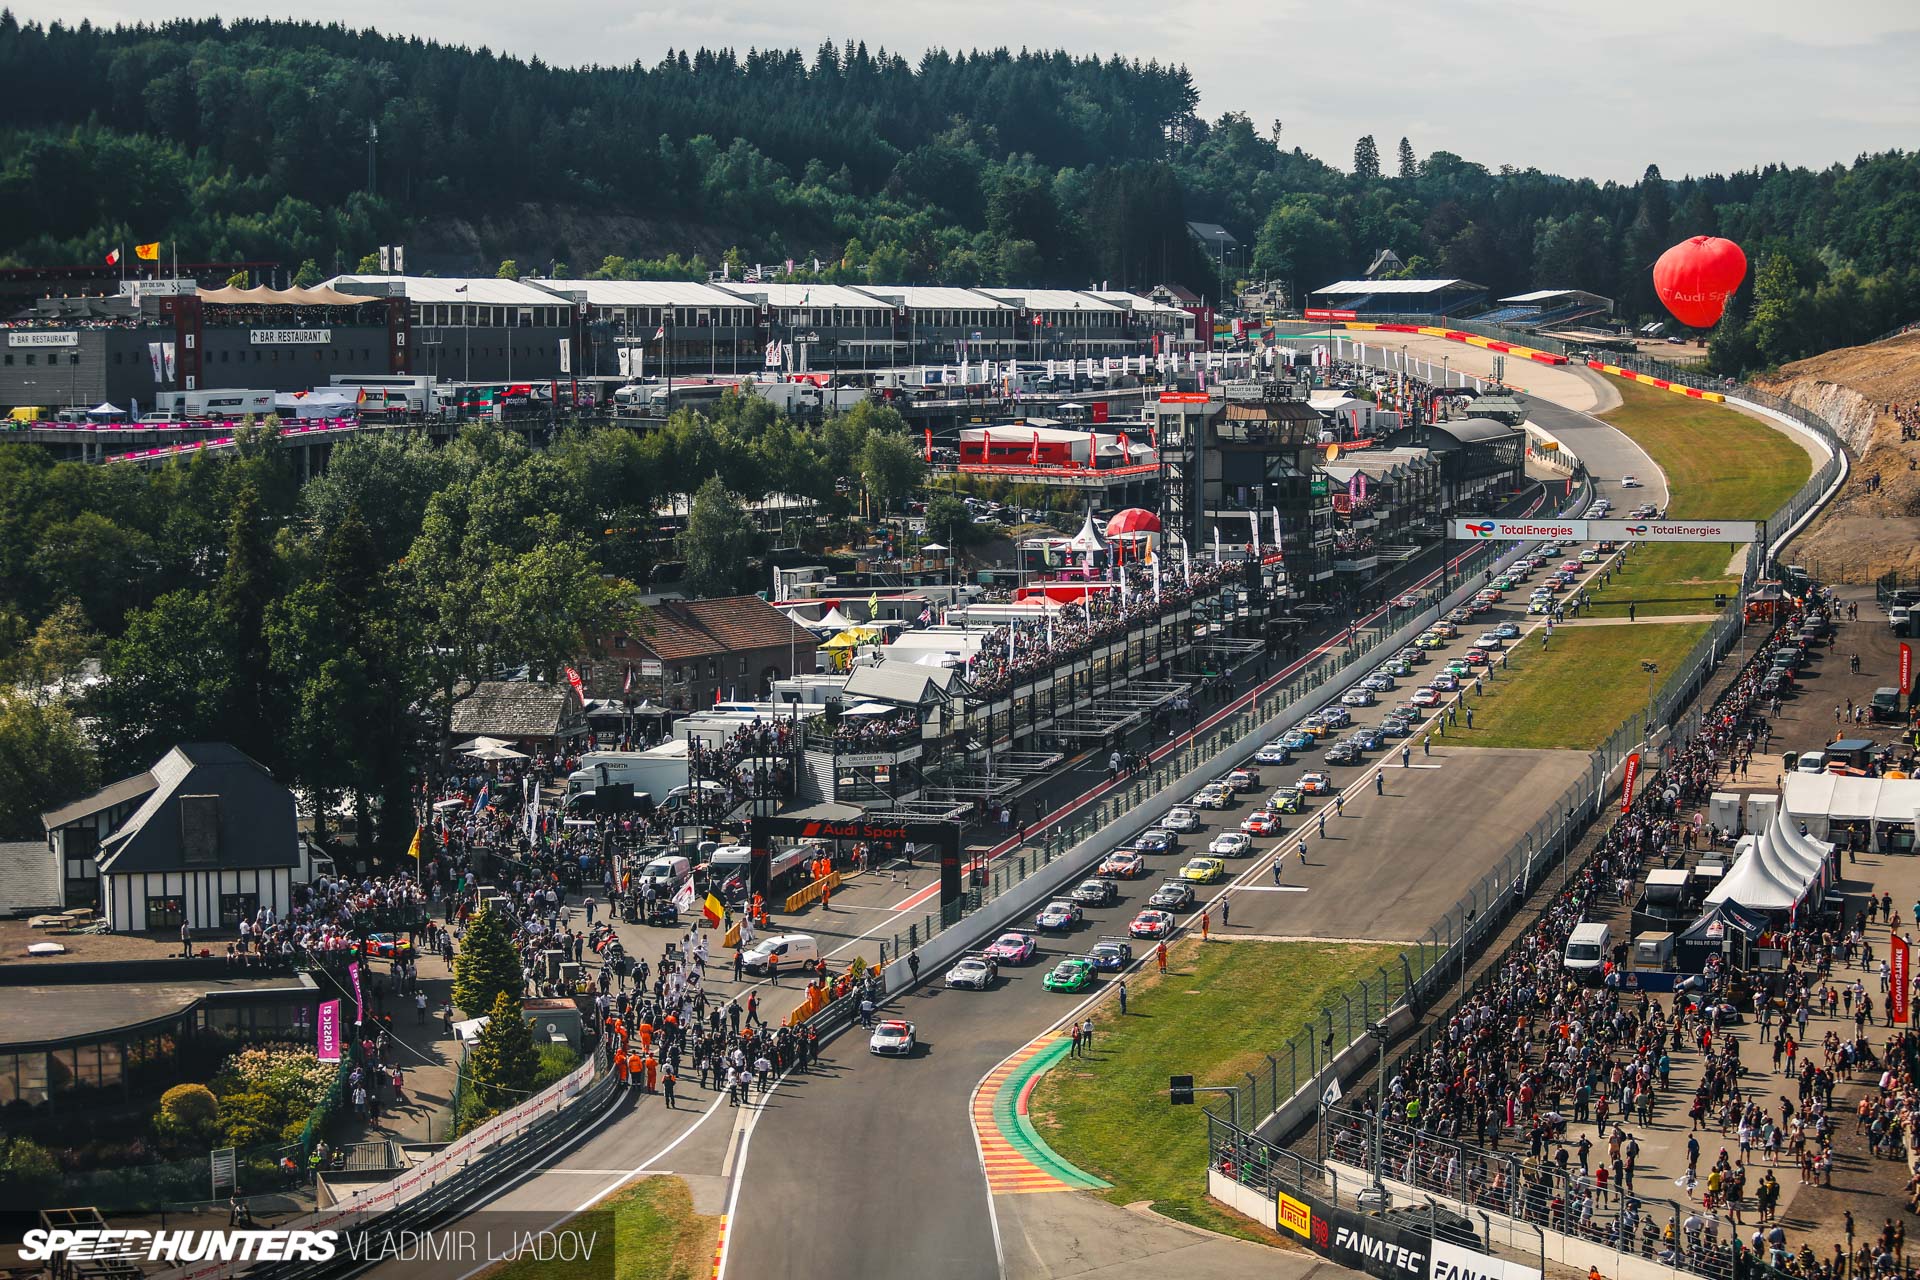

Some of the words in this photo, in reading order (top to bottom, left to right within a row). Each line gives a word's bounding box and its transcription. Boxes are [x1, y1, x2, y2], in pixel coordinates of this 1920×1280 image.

[1674, 291, 1705, 302] Audi
[581, 302, 586, 313] 3
[17, 335, 29, 344] BAR
[32, 335, 70, 344] RESTAURANT
[260, 331, 274, 342] BAR
[277, 331, 322, 342] RESTAURANT
[398, 333, 404, 344] 2
[1500, 524, 1573, 538] TotalEnergies
[1651, 525, 1721, 536] TotalEnergies
[1622, 760, 1635, 807] CROWDSTRIKE
[822, 823, 858, 837] Audi
[863, 825, 907, 839] Sport
[1281, 1198, 1308, 1231] PIRELLI
[1335, 1228, 1420, 1273] FANATEC
[1434, 1260, 1501, 1280] FAN
